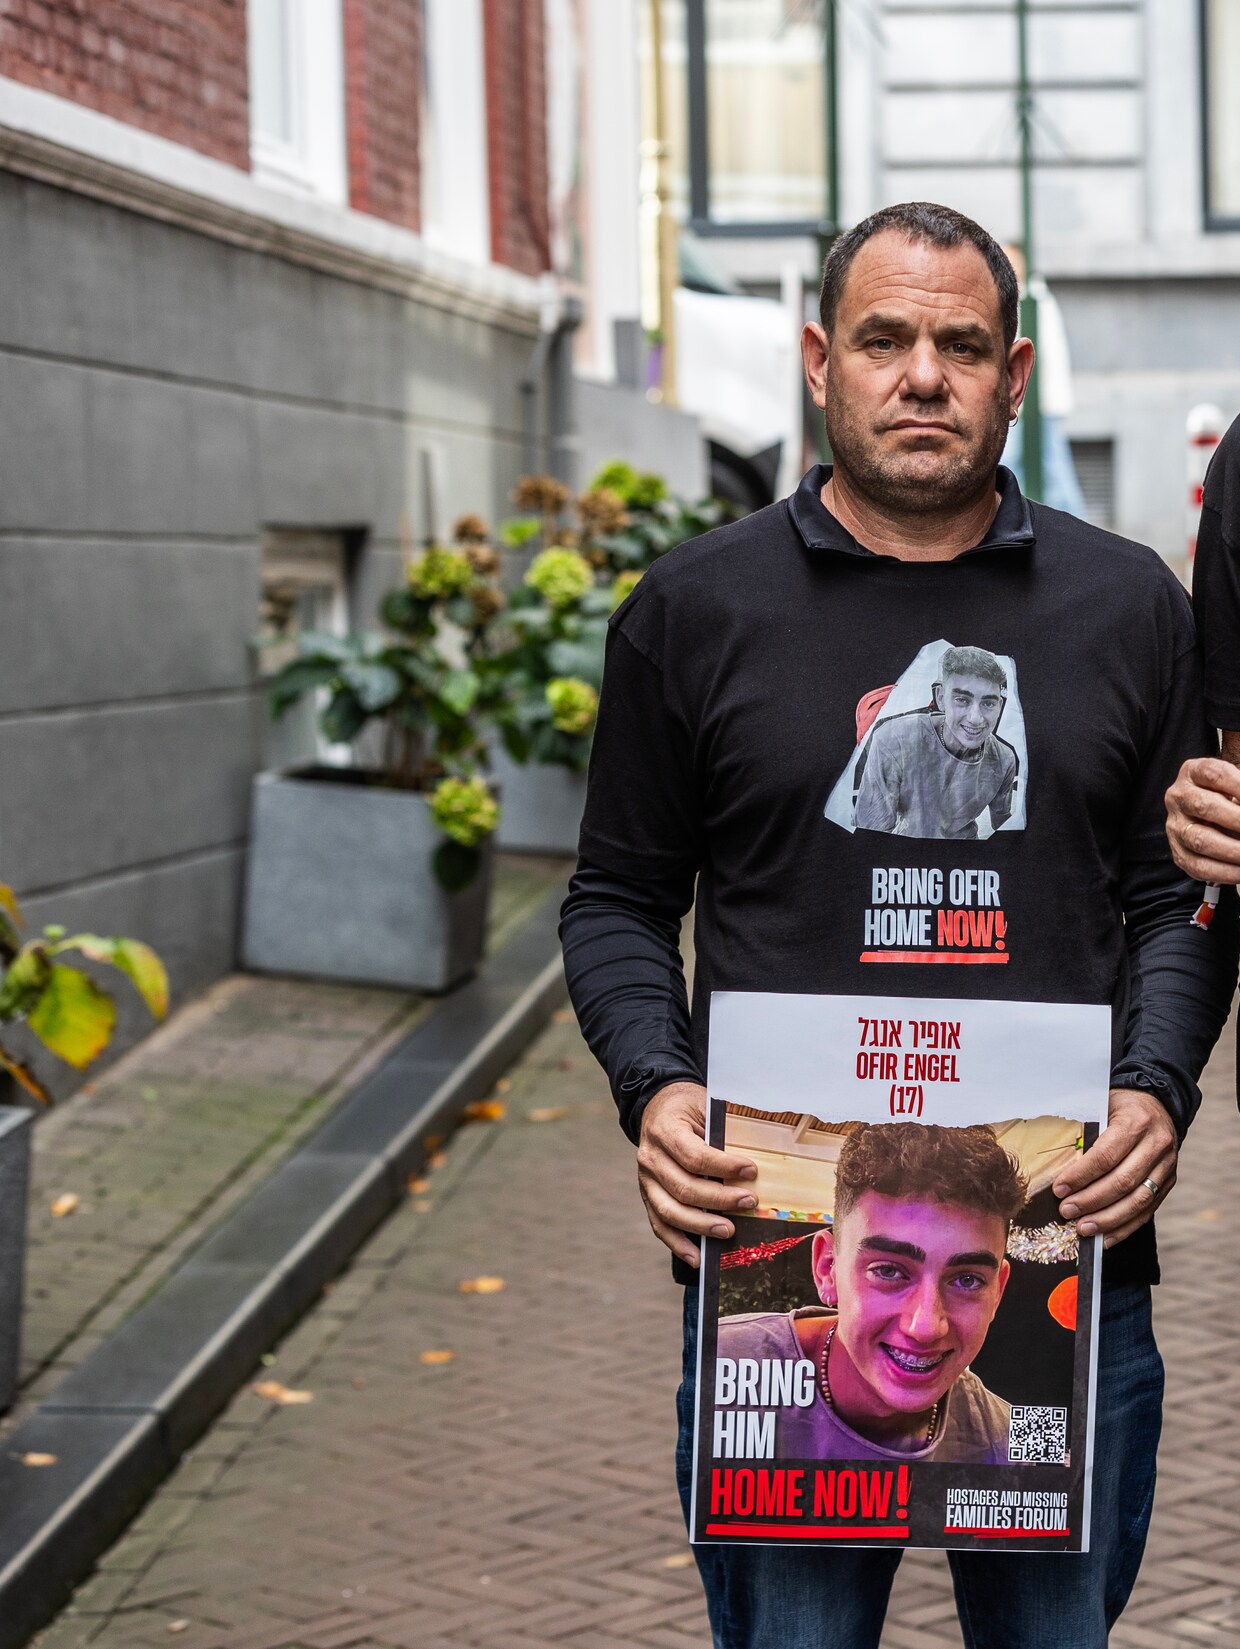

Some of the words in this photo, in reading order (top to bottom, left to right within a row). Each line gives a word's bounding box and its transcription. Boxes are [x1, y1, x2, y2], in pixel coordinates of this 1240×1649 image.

[872, 867, 943, 905] BRING
[949, 869, 1001, 907] OFIR
[864, 909, 932, 946] HOME
[937, 910, 1008, 950] NOW!
[857, 1016, 902, 1048] אנגל
[908, 1020, 961, 1050] אופיר
[856, 1051, 898, 1080] OFIR
[904, 1053, 960, 1082] ENGEL
[889, 1084, 923, 1117] (17)
[714, 1357, 816, 1407] BRING
[712, 1410, 775, 1459] HIM
[710, 1468, 805, 1517] HOME
[813, 1465, 913, 1519] NOW!
[946, 1488, 998, 1506] HOSTAGES
[1000, 1490, 1021, 1507] AND
[1022, 1491, 1068, 1508] MISSING
[945, 1505, 1011, 1529] FAMILIES
[1015, 1507, 1068, 1531] FORUM
